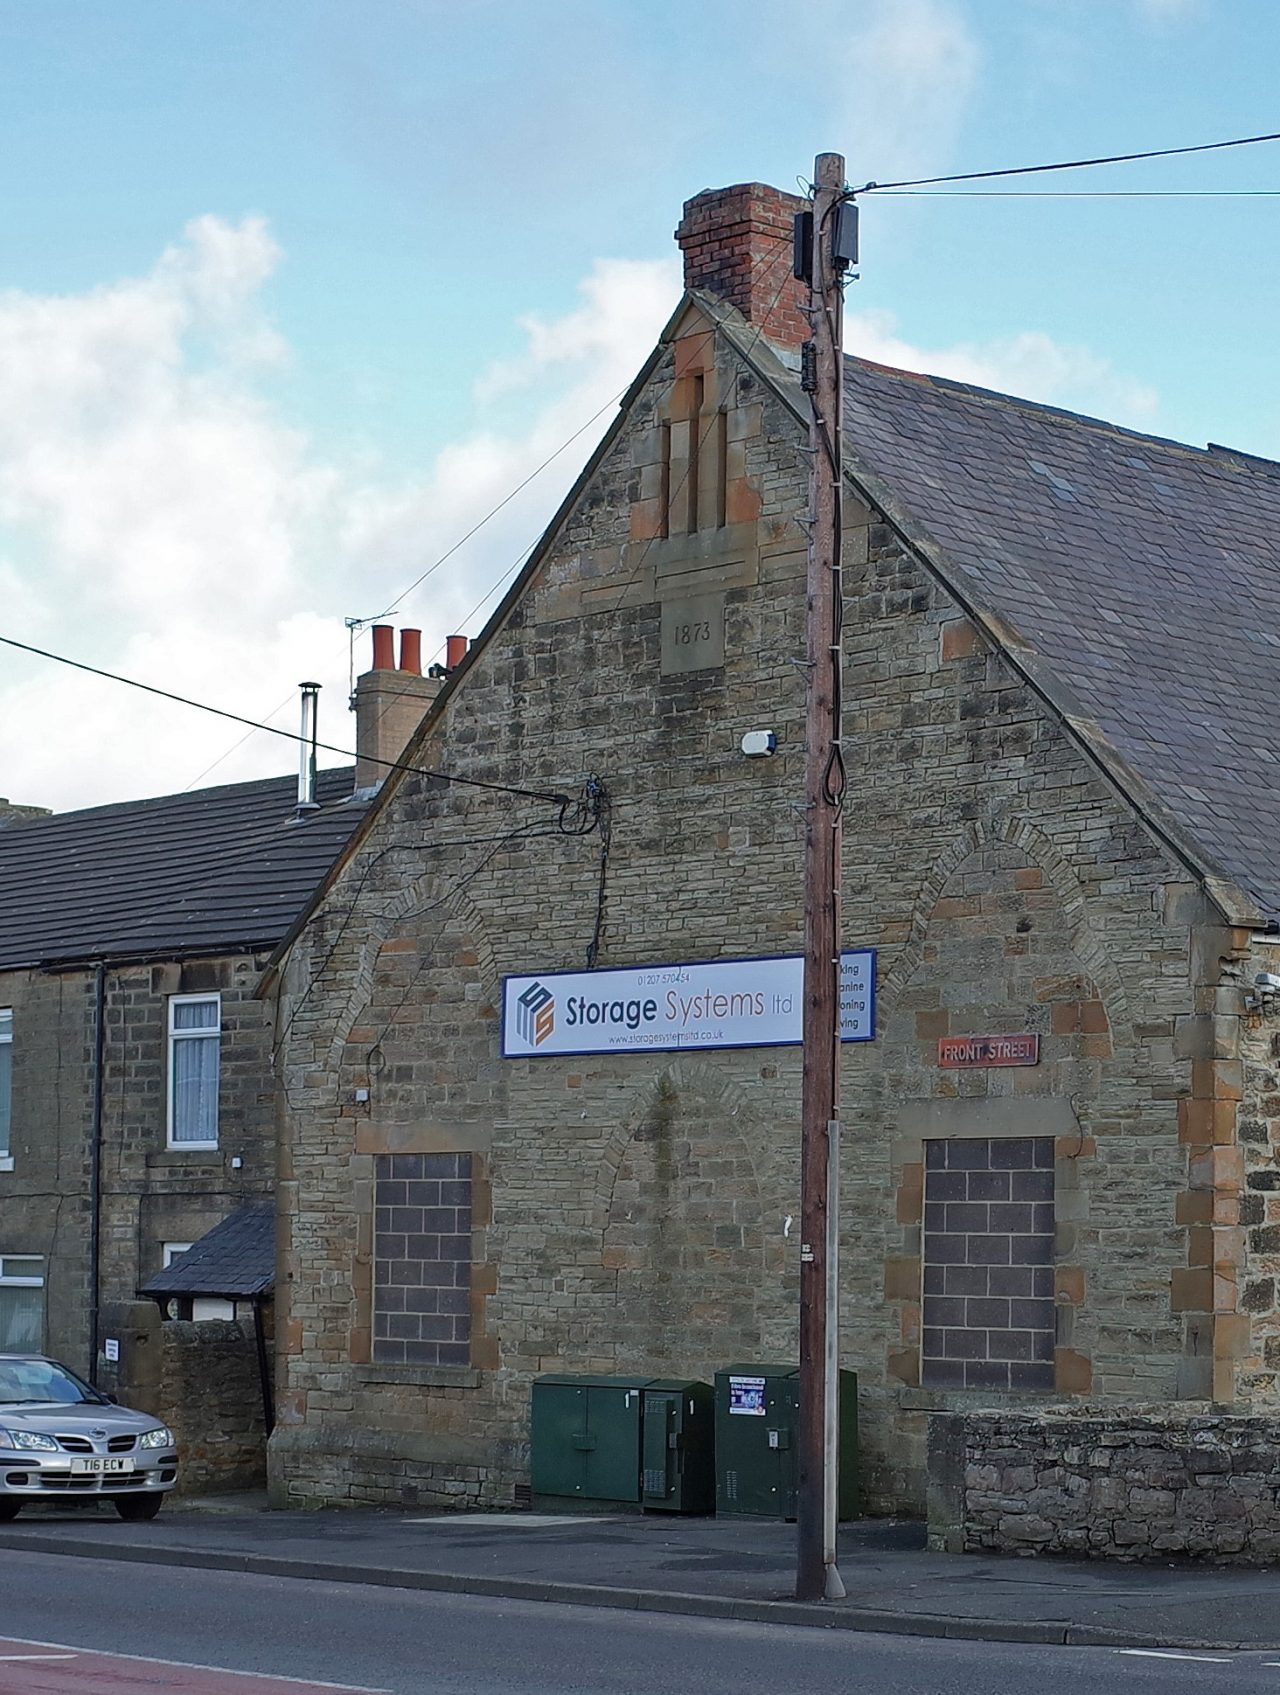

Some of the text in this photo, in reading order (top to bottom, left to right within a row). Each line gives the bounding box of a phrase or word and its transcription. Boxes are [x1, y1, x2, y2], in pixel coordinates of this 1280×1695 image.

[675, 621, 710, 645] 1873
[637, 974, 660, 985] 01207
[840, 981, 864, 992] anine
[565, 988, 793, 1030] Storage Systems ltd
[840, 999, 865, 1012] oning
[840, 1017, 859, 1030] ving
[943, 1041, 1032, 1061] FRONT STREET
[83, 1459, 100, 1470] T16
